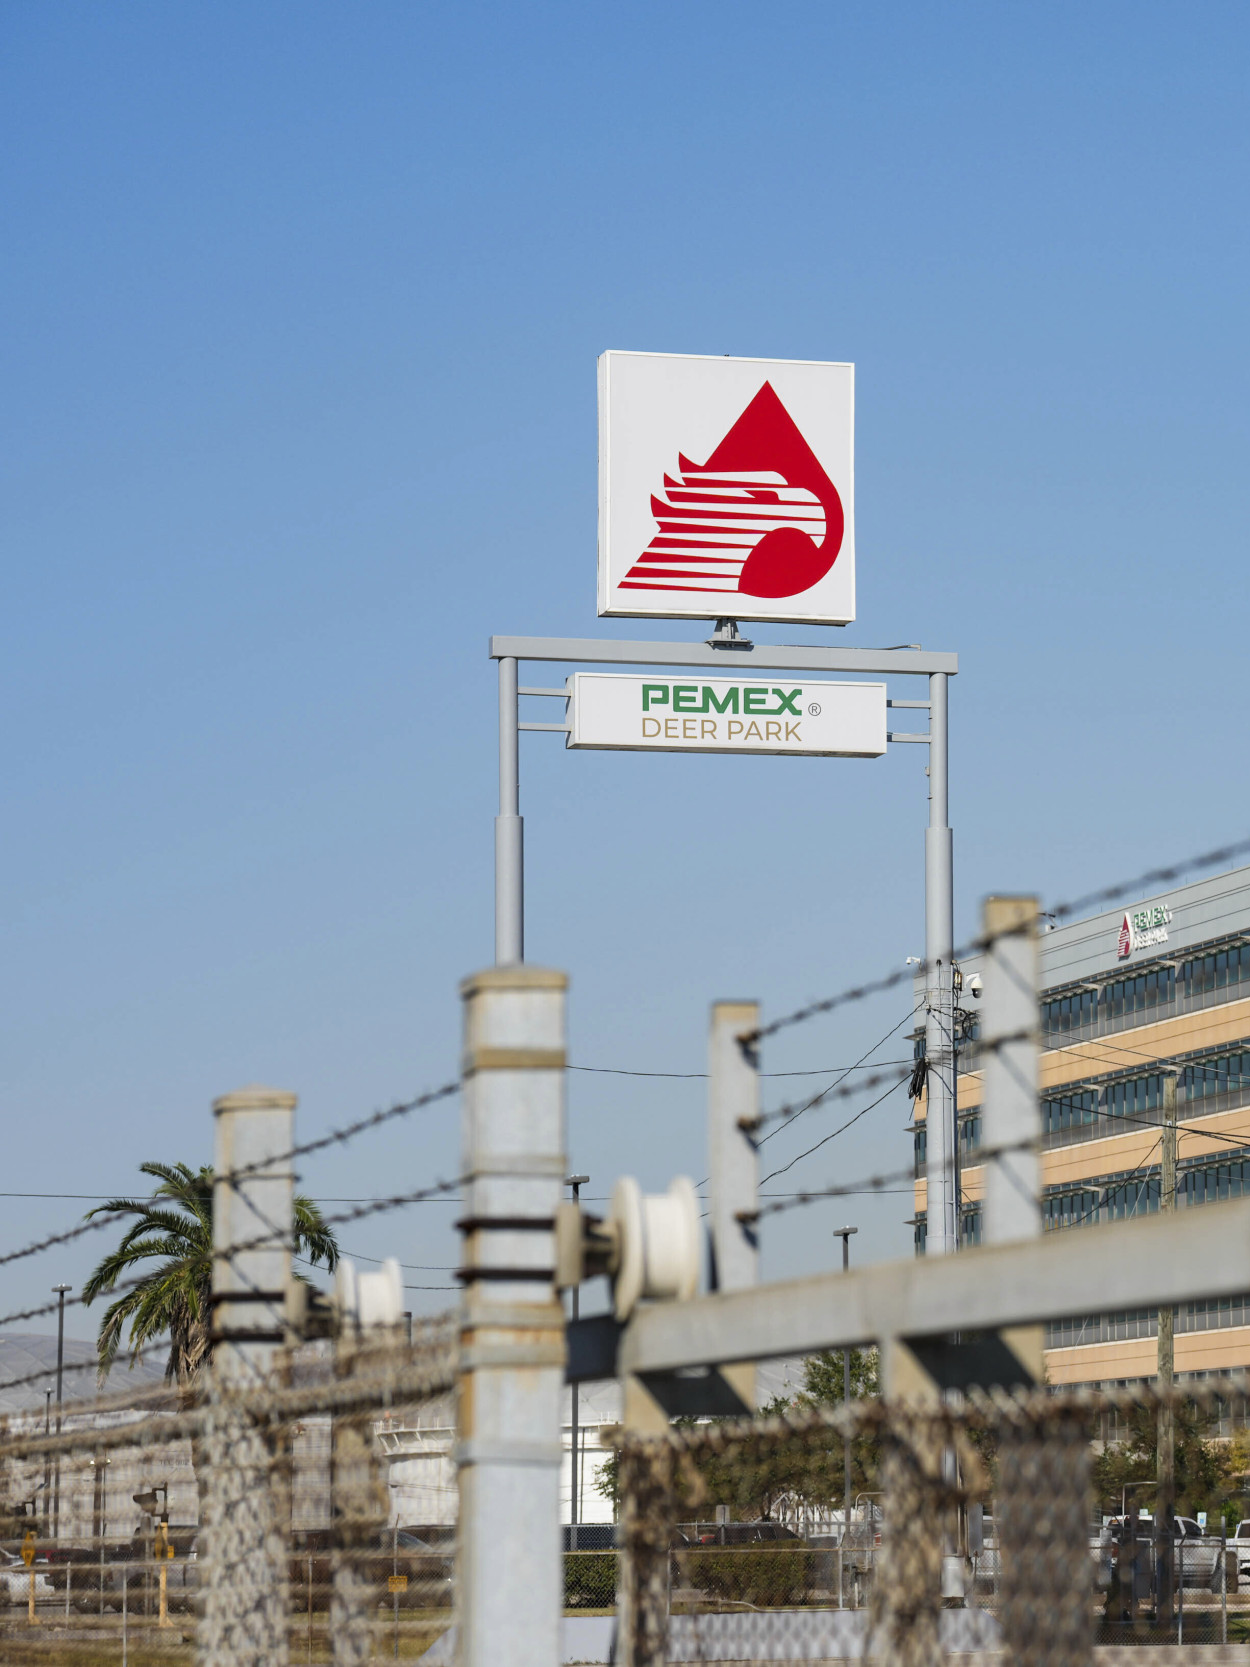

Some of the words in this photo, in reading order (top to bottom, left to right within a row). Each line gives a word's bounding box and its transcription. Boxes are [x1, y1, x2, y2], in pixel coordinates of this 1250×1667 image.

[642, 684, 802, 716] PEMEX
[642, 717, 717, 739] DEER
[728, 720, 802, 742] PARK
